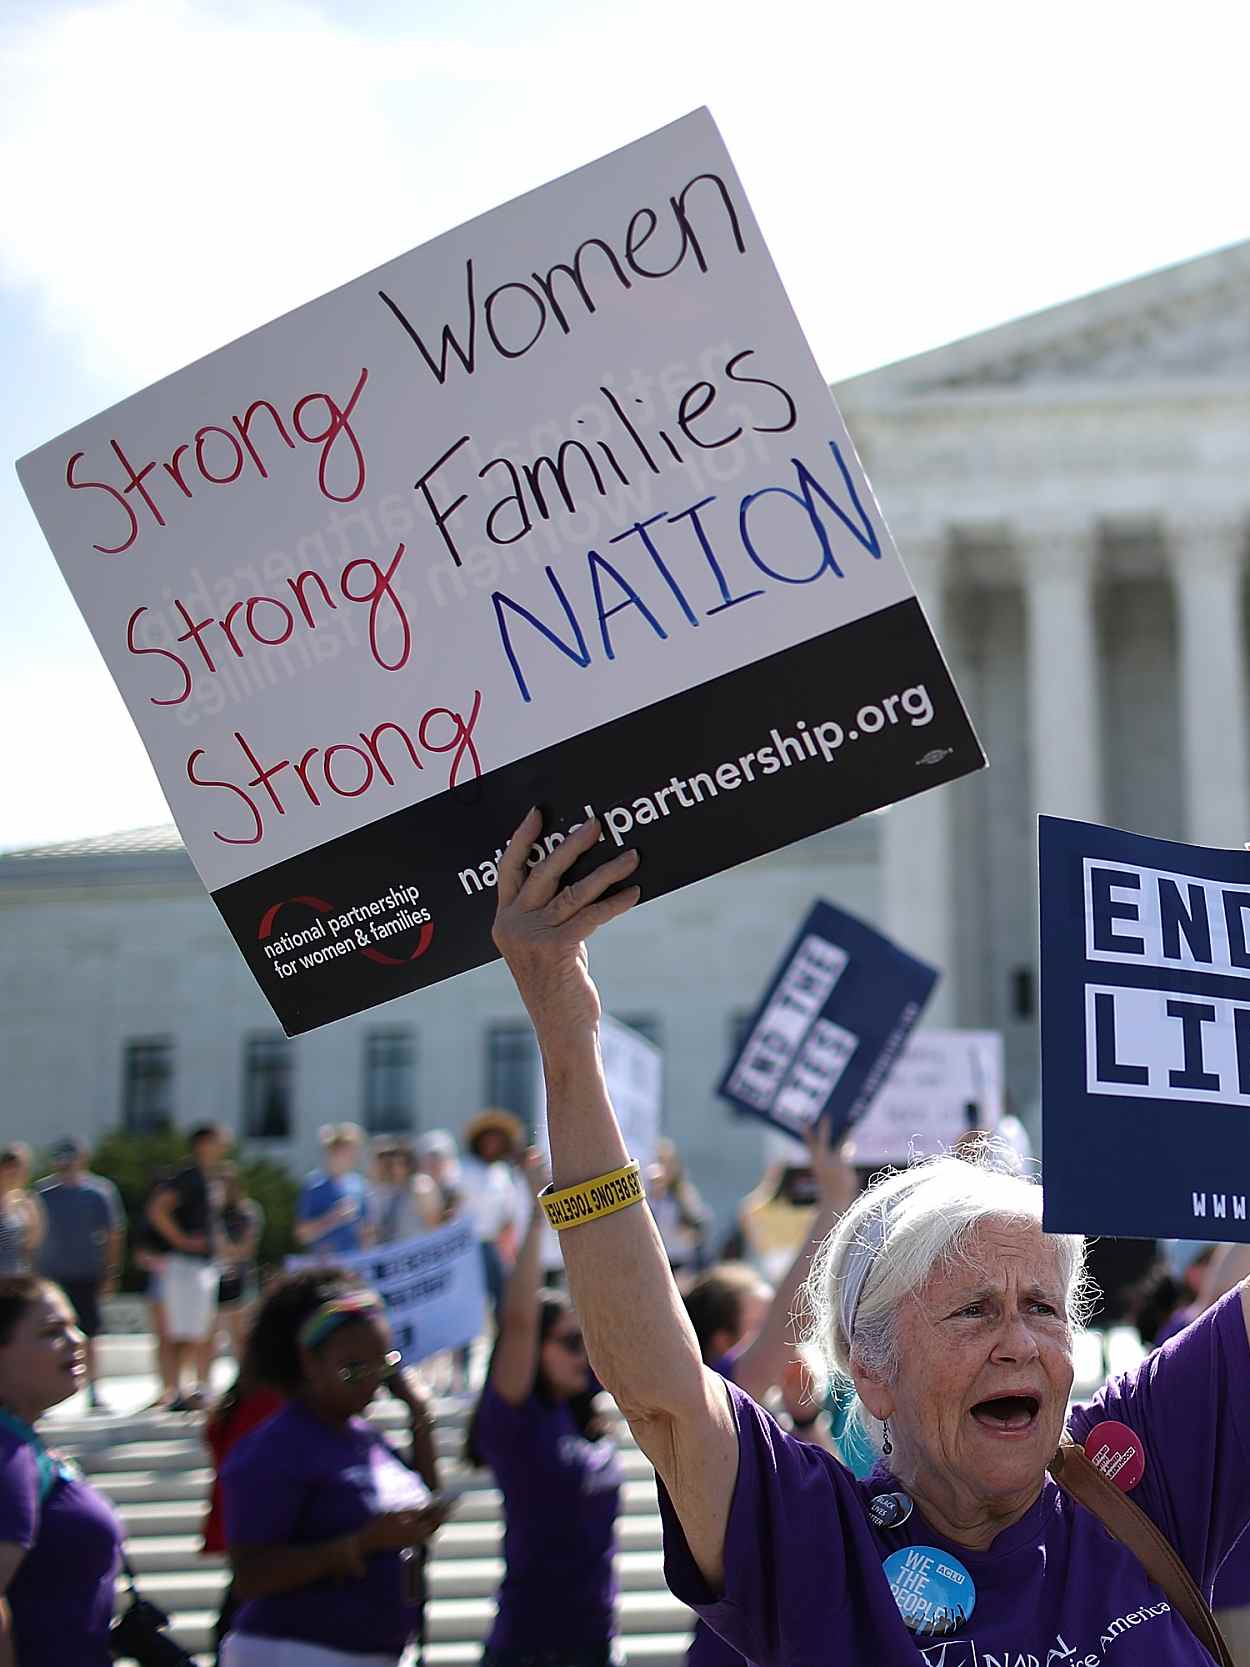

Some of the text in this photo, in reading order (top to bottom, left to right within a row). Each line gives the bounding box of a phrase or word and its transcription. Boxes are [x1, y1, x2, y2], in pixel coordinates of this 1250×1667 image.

[67, 174, 746, 553] Strong Women
[127, 350, 797, 705] Strong Families
[187, 440, 882, 845] Strong NATION
[457, 681, 933, 895] naonlpartnership.org
[264, 885, 420, 959] national partnership
[274, 907, 432, 979] for women & families
[590, 1178, 632, 1210] BELONG
[896, 1566, 930, 1595] THE
[904, 1550, 935, 1577] WE
[938, 1565, 964, 1584] ACLU
[1100, 1601, 1171, 1654] America
